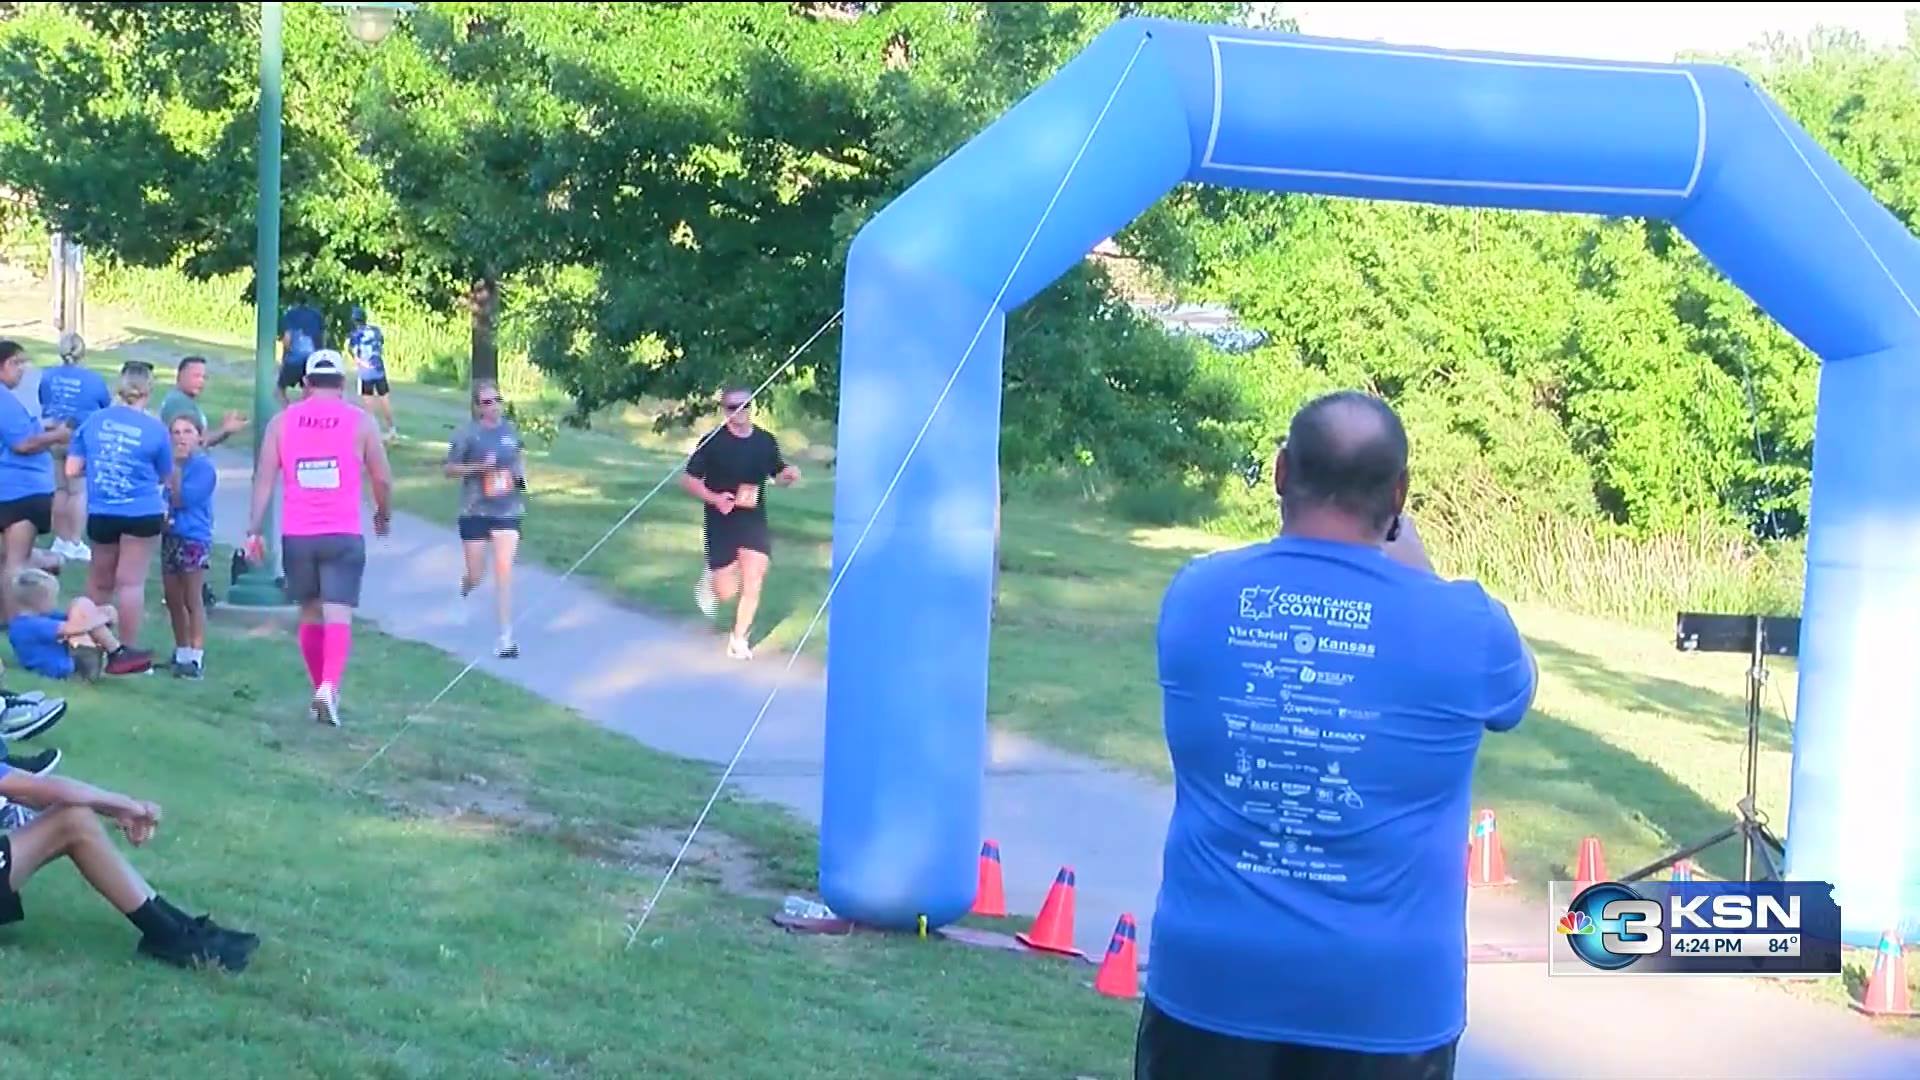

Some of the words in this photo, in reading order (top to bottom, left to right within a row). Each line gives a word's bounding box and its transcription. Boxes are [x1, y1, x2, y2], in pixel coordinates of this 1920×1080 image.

[1278, 592, 1321, 606] COLON
[1322, 596, 1373, 611] CANCER
[1277, 602, 1372, 624] COALITION
[1318, 636, 1376, 655] Kansas
